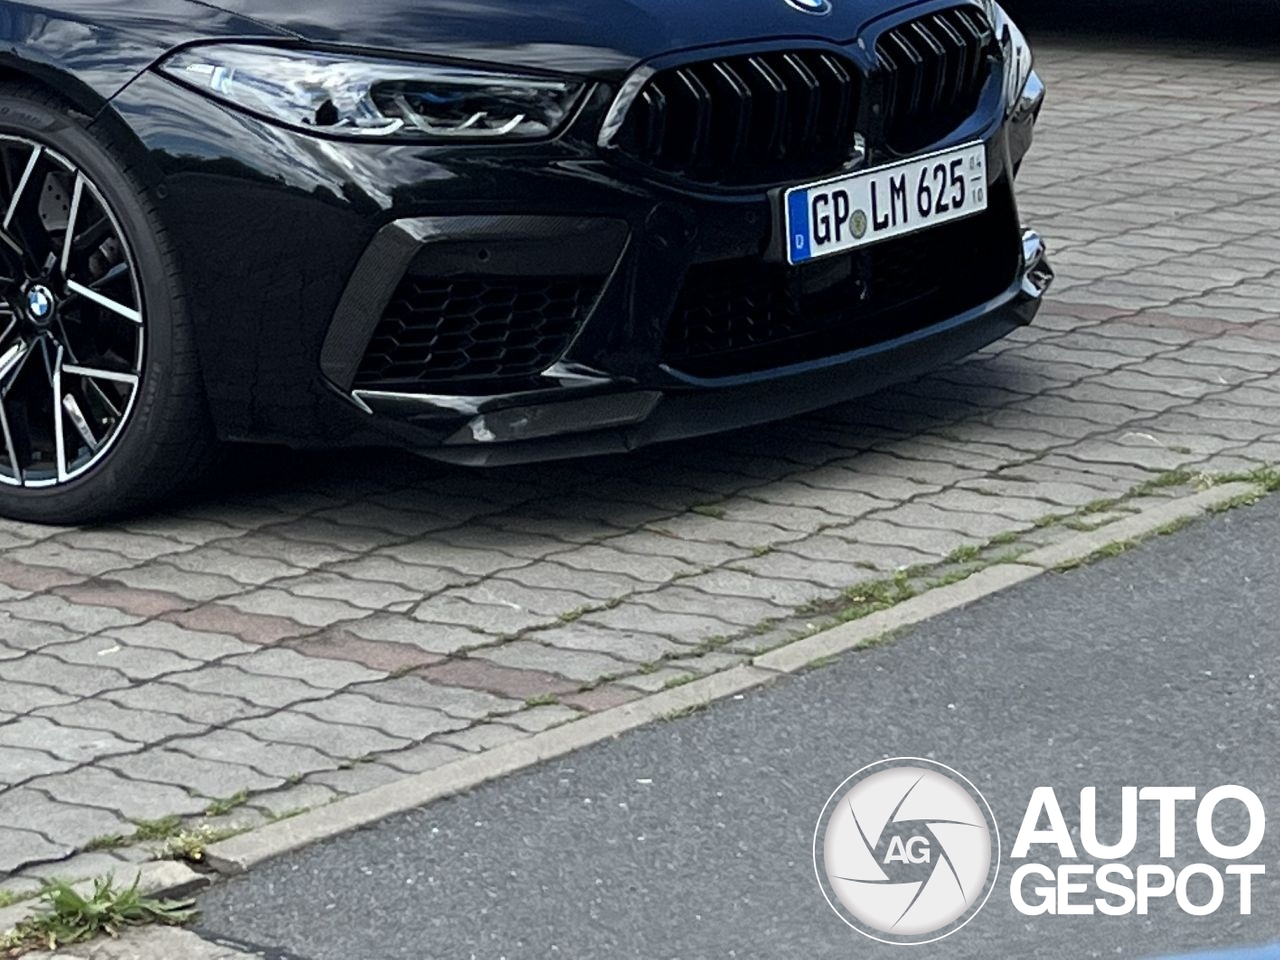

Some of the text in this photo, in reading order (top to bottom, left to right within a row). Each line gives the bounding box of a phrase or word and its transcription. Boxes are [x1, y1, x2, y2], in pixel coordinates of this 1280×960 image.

[812, 158, 965, 246] GP LM 625
[795, 234, 805, 250] D
